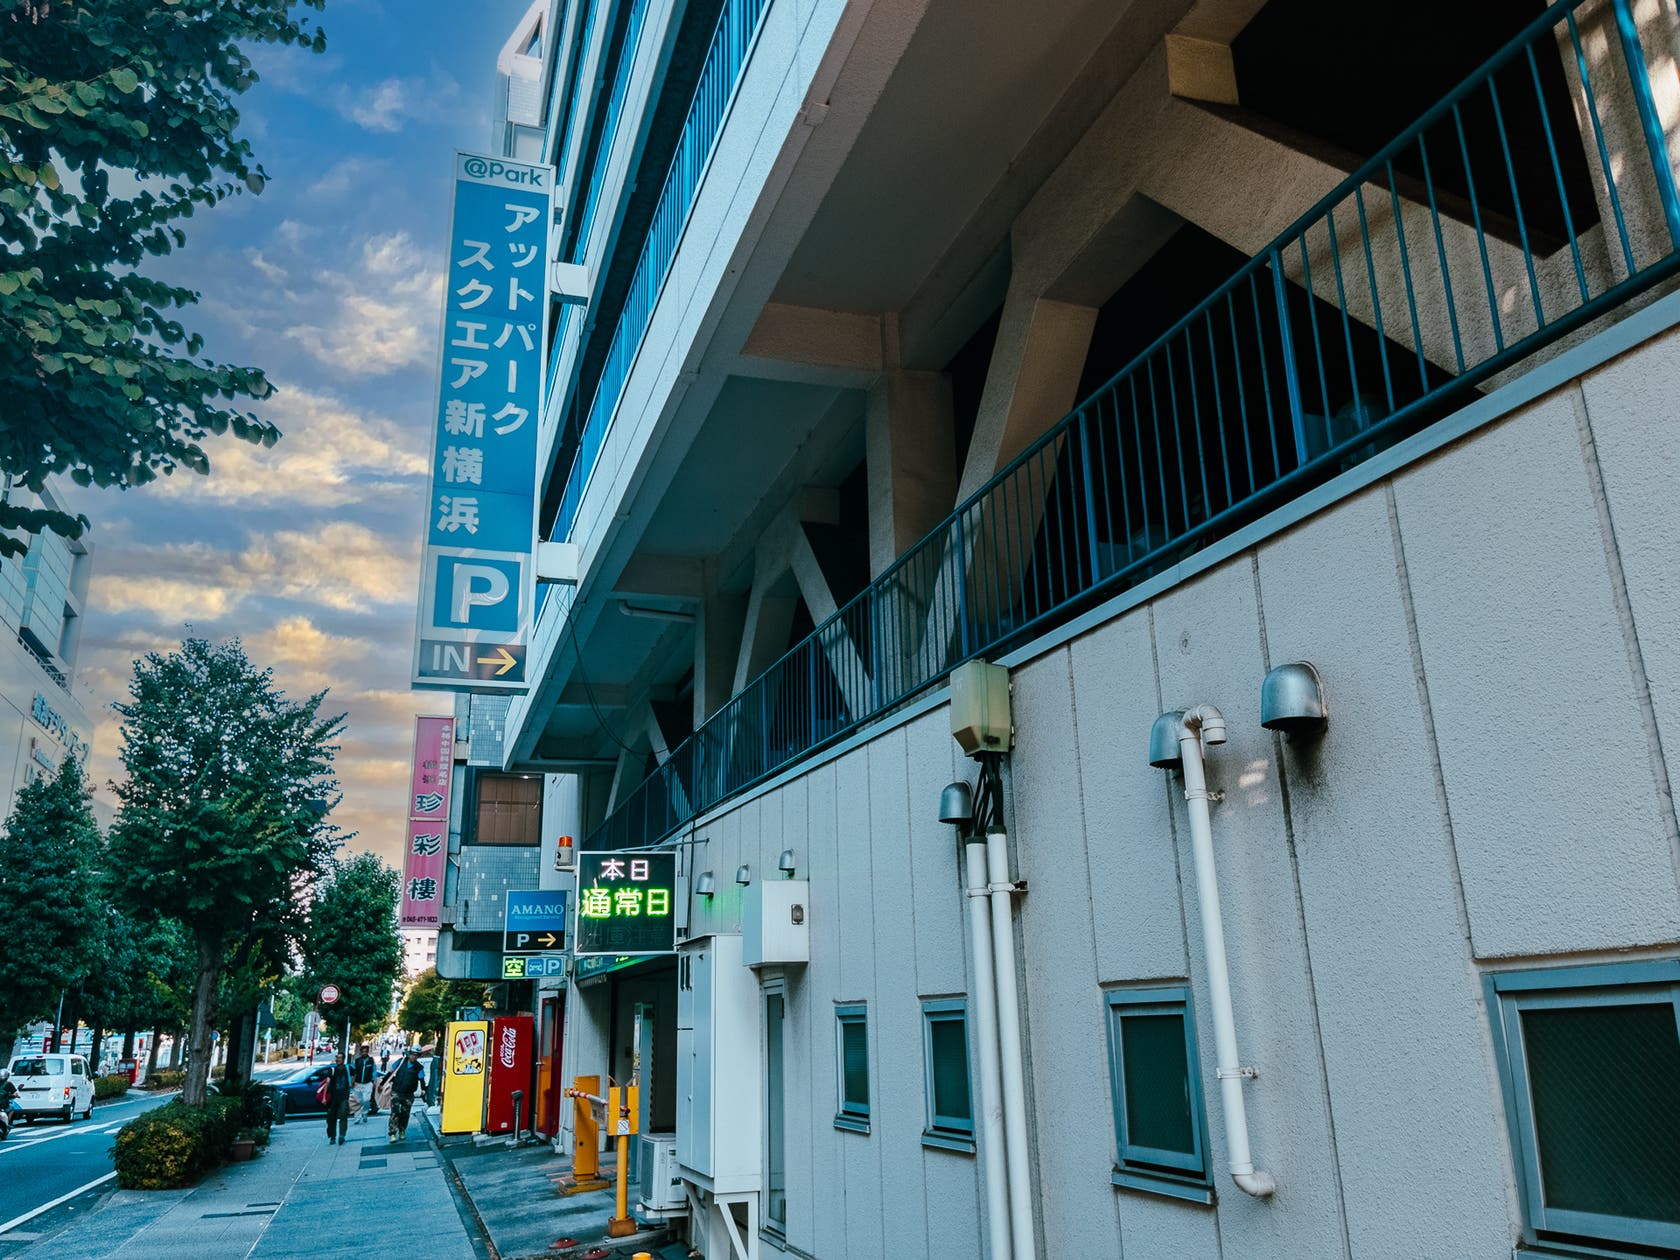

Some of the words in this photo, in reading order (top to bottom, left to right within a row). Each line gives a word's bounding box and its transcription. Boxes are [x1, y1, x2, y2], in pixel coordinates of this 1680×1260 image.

[464, 157, 542, 187] @Park
[492, 203, 541, 435] アットパーク
[437, 240, 495, 535] スクエア新横浜
[450, 562, 510, 624] P
[432, 645, 471, 673] IN
[601, 858, 649, 881] 本日
[511, 903, 564, 915] AMANO
[581, 888, 669, 918] 通常日
[516, 933, 530, 948] P
[504, 958, 524, 977] 空
[548, 959, 561, 974] P
[456, 1032, 477, 1054] 100
[501, 1025, 517, 1068] Coca-Cola
